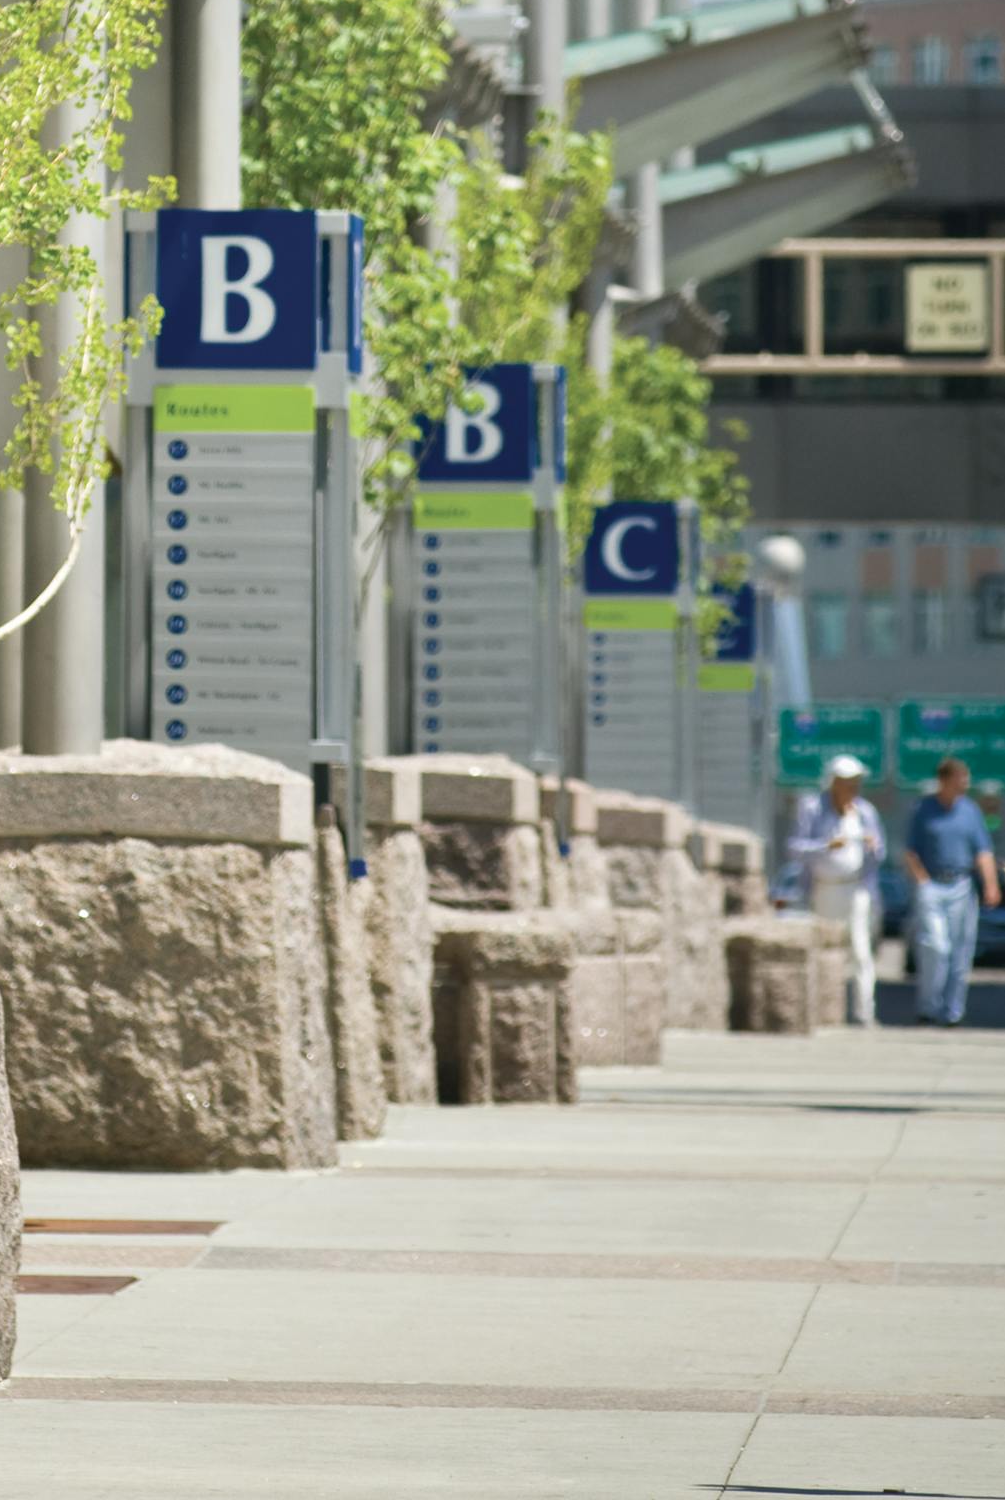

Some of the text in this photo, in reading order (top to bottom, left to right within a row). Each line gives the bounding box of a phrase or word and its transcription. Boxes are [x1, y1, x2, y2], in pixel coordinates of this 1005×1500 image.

[200, 235, 276, 344] B
[445, 381, 503, 463] B
[602, 517, 655, 580] C
